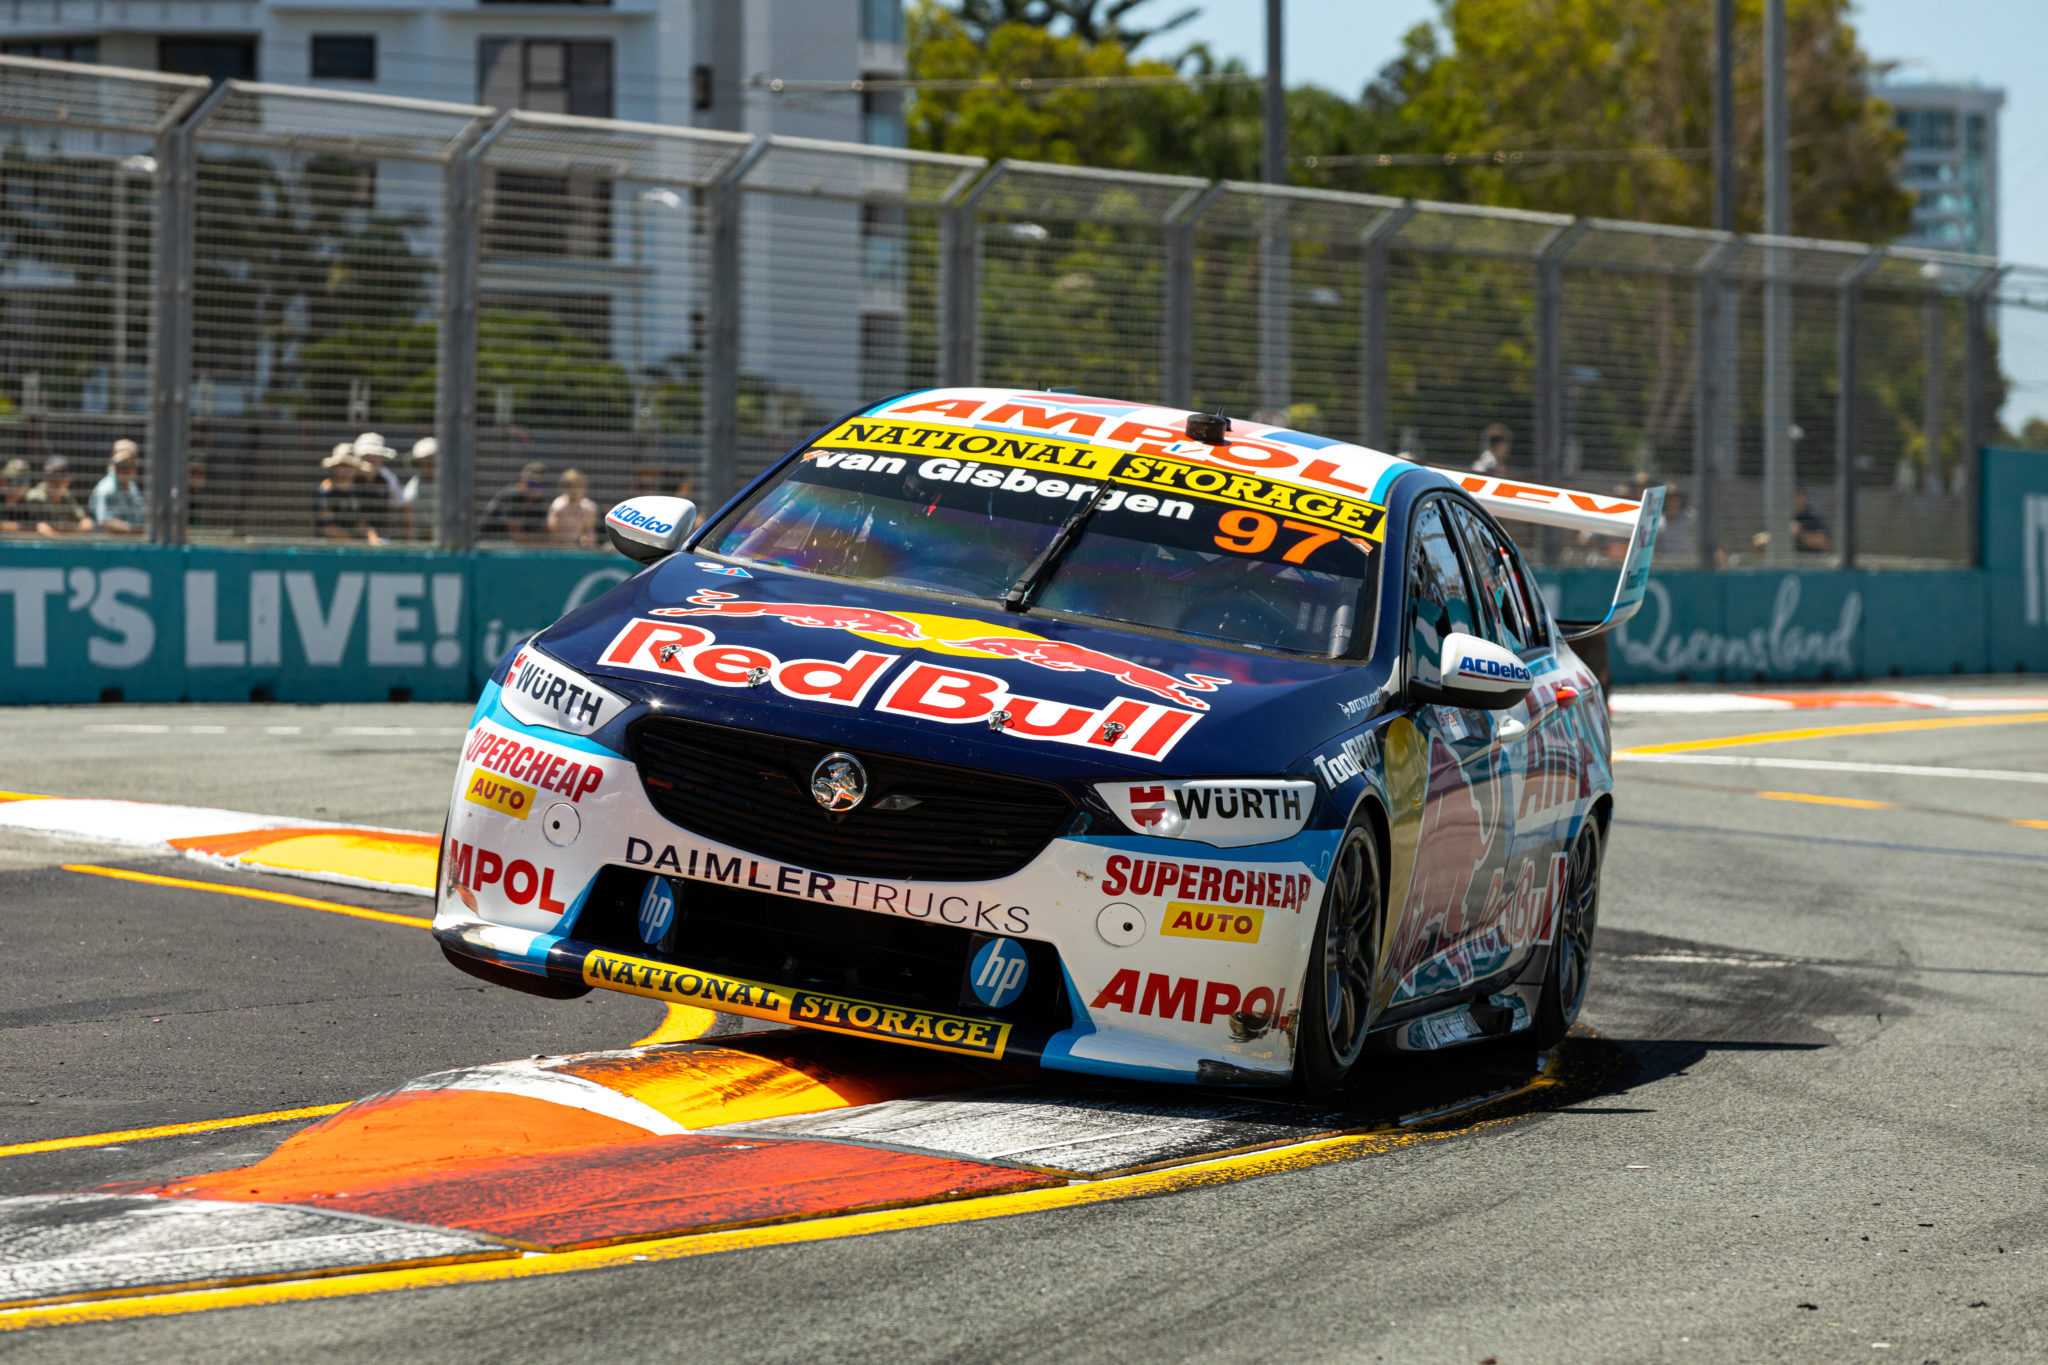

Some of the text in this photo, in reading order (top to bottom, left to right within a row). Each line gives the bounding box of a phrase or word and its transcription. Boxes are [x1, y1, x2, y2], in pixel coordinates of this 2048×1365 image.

[834, 423, 1369, 525] NATIONAL STORAGE
[891, 398, 1369, 494] AMPOL
[610, 504, 673, 534] ACDelco
[817, 450, 1196, 522] van Gisbergen
[1213, 510, 1340, 565] 97
[184, 570, 464, 668] LIVE!
[515, 661, 603, 727] WÜRTH
[597, 618, 1206, 763] Red Bull
[1347, 686, 1384, 714] DUNLOP
[1459, 656, 1531, 680] ACDelco
[1313, 729, 1380, 790] ToolPRO
[471, 778, 525, 810] AUTO
[1174, 788, 1301, 821] WÜRTH
[448, 838, 566, 916] MPOL
[625, 837, 1030, 935] DAIMLER TRUCKS
[640, 876, 670, 942] hp
[1101, 855, 1312, 914] SUPERCHEAP
[1172, 911, 1253, 935] AUTO
[590, 955, 991, 1048] NATIONAL STORAGE
[976, 939, 1025, 1006] hp
[1089, 967, 1290, 1030] AMPOL
